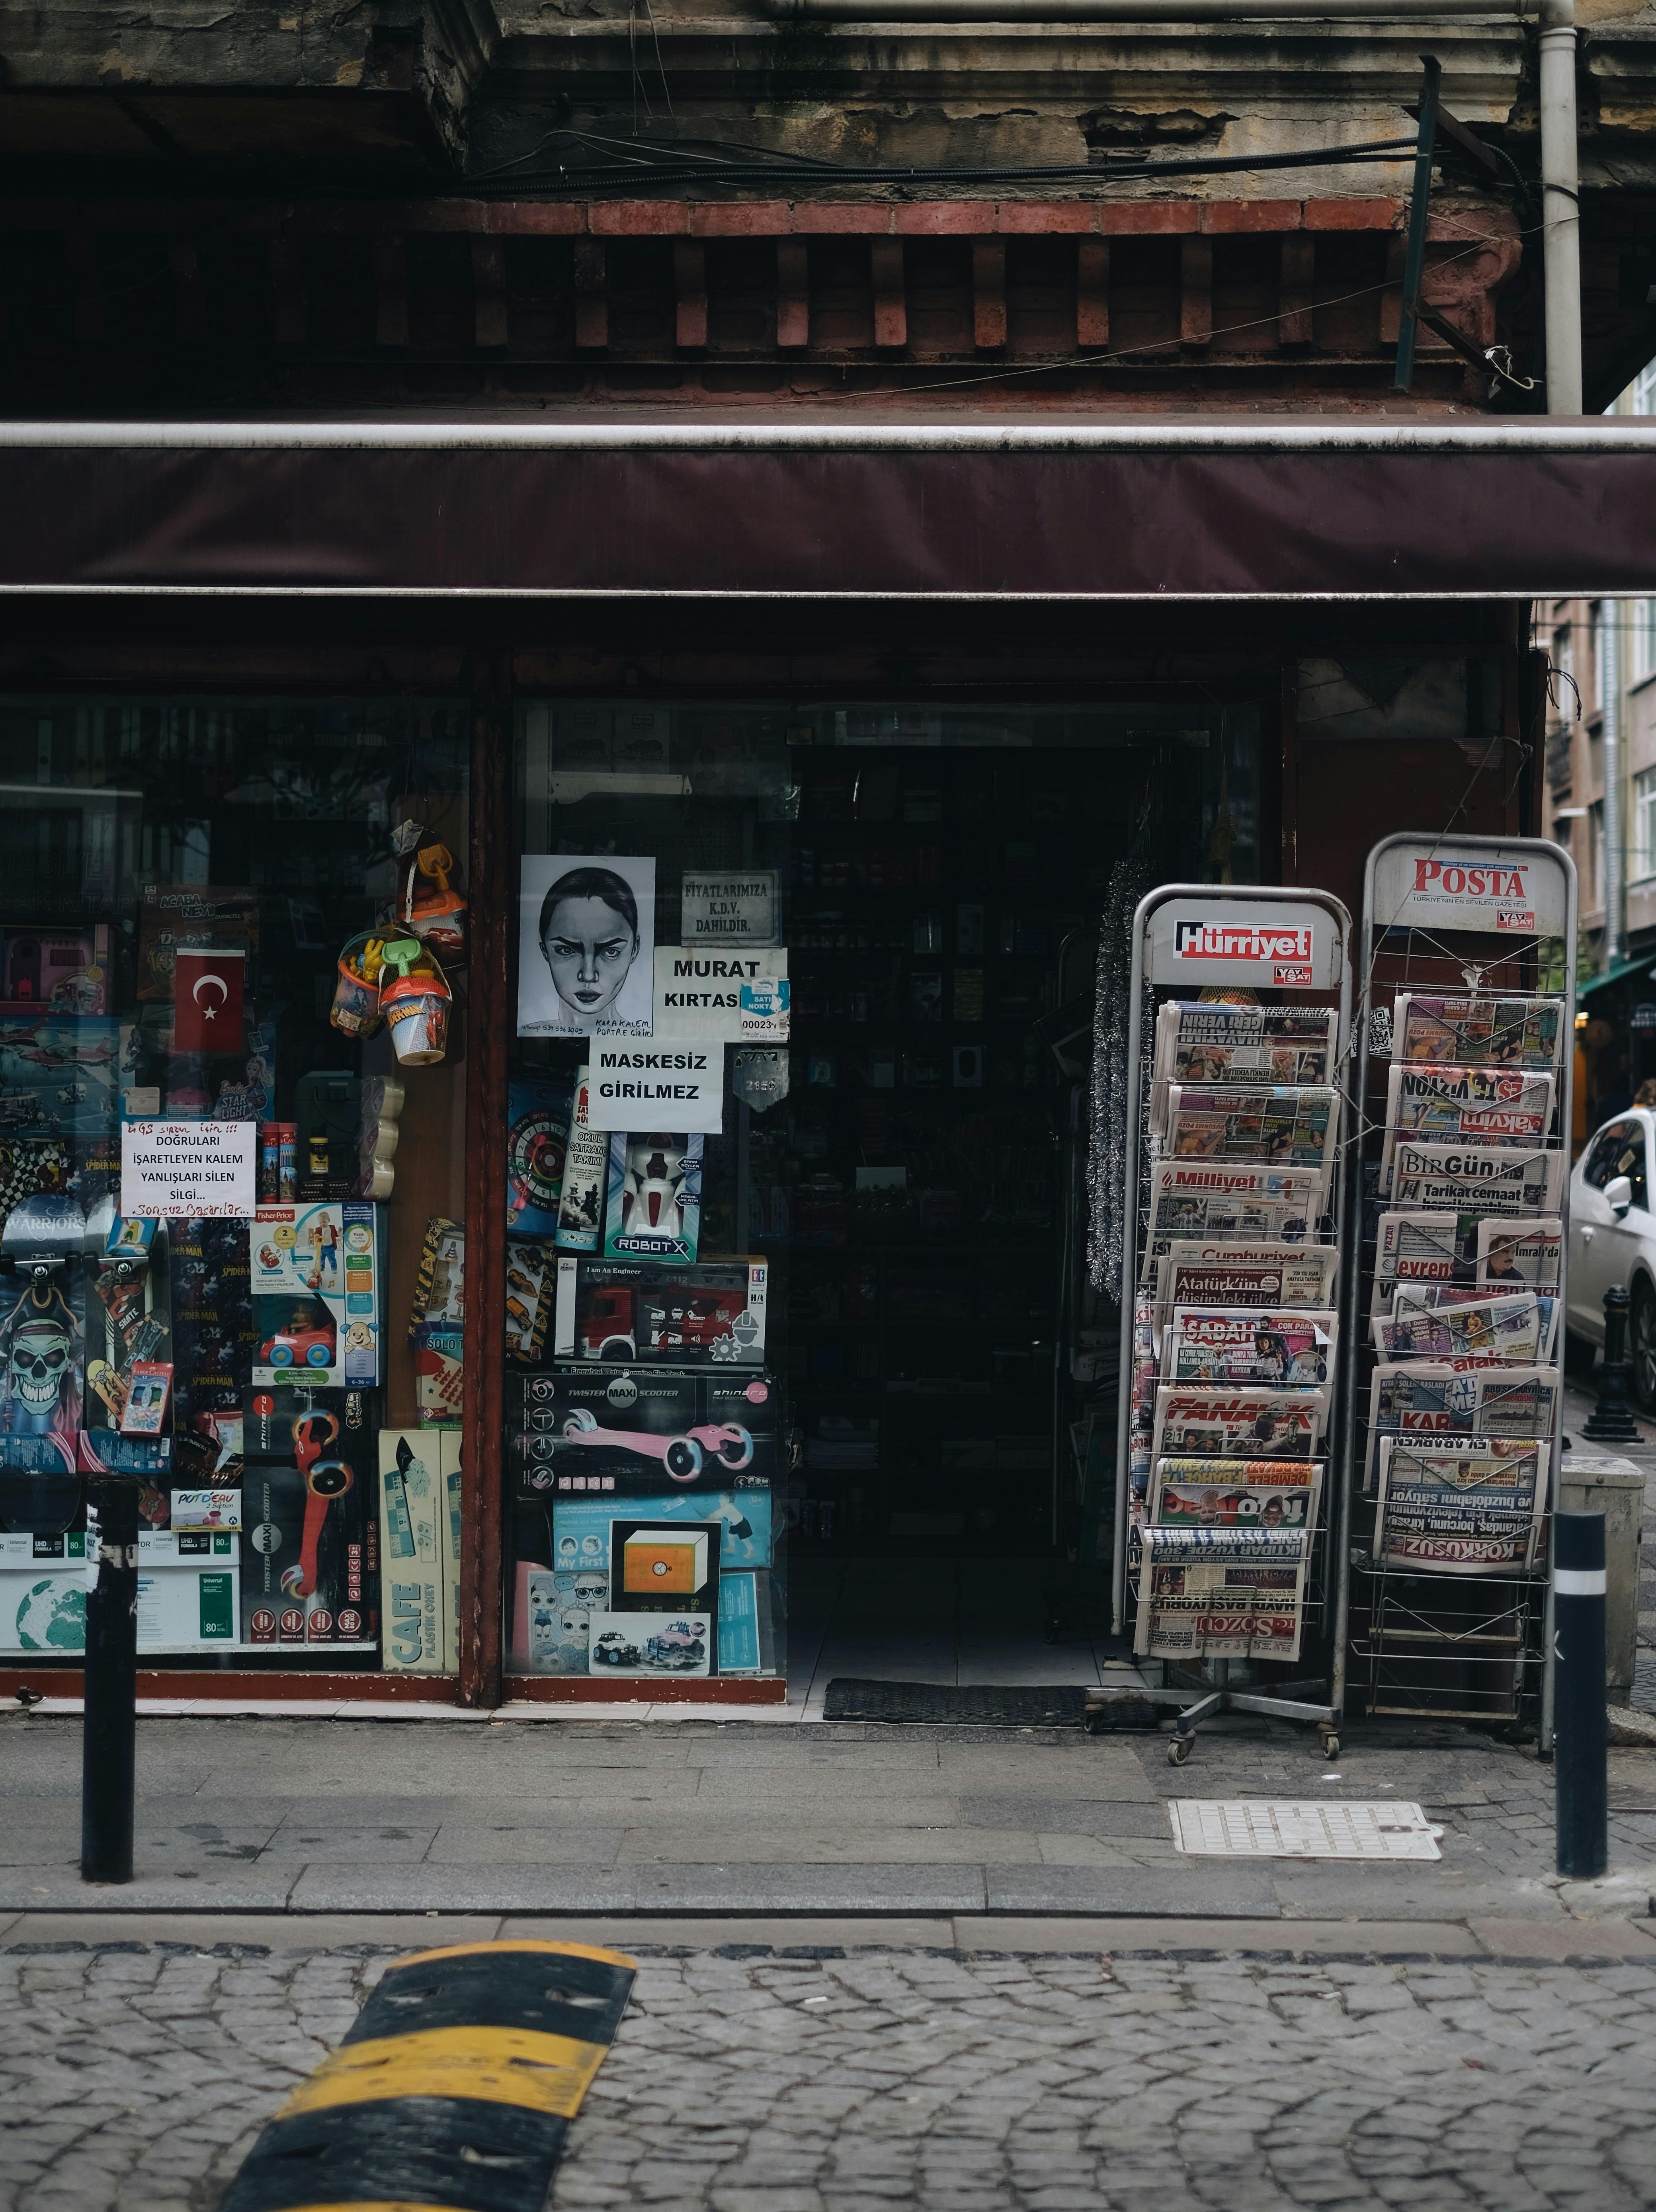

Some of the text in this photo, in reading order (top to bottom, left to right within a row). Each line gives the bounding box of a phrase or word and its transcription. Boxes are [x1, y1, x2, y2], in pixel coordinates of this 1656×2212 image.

[1413, 859, 1527, 898] POSTA
[685, 881, 767, 897] FİYATLARIMIZA
[160, 894, 201, 908] ACABA
[709, 902, 740, 915] K.D.V.
[1500, 913, 1525, 921] YAY
[1509, 918, 1533, 927] SAT
[696, 917, 750, 932] DAHİLDİR.
[1181, 927, 1308, 960] Hürriyet
[674, 960, 760, 977] MURAT
[1278, 968, 1302, 977] YAY
[1287, 974, 1309, 982] SAT
[1183, 1015, 1261, 1029] GERİ VERİN
[601, 1052, 707, 1069] MASKESİZ
[600, 1080, 699, 1099] GİRİLMEZ
[222, 1095, 246, 1108] STAR
[222, 1105, 247, 1119] LIGHT
[1463, 1113, 1538, 1134] Takvim
[156, 1134, 220, 1145] DOĞRULARI
[578, 1132, 603, 1144] OKUL
[570, 1142, 608, 1157] SATRANÇ
[84, 1160, 121, 1171] SPIDER-MA
[133, 1153, 243, 1166] İŞARETLEYEN KALEM
[573, 1154, 602, 1166] TAKIMI
[141, 1171, 234, 1183] YANLIŞLARI SİLEN
[1176, 1171, 1256, 1194] Milliyet
[170, 1189, 205, 1199] SİLGİ...
[1424, 1184, 1521, 1201] Tarikat cemaat
[1385, 1225, 1394, 1251] PAZAR
[619, 1239, 672, 1252] ROBOT
[1202, 1248, 1305, 1265] Cumhuriyet
[1177, 1276, 1258, 1290] Atatürk'ün
[118, 1307, 139, 1330] SKATE
[1186, 1322, 1256, 1341] SABAH
[428, 1338, 455, 1350] SOLO
[192, 1376, 234, 1387] SPIDER-MAN
[608, 1389, 636, 1398] MAXI
[1166, 1432, 1182, 1441] 2 1
[178, 1493, 202, 1504] POT
[1390, 1489, 1531, 1509] ve buzdolabını satıyor
[1427, 1518, 1474, 1533] borcunu,
[263, 1525, 271, 1552] MAXI
[1154, 1544, 1300, 1556] İKTİDAR YÜZDE 300
[1406, 1538, 1515, 1558] KORKUSUZ
[557, 1555, 604, 1570] My First
[392, 1582, 422, 1663] CAFE
[423, 1582, 435, 1658] PLASTİK OKEY
[1197, 1616, 1274, 1637] SÖZCÜ
[206, 1623, 217, 1632] 80
